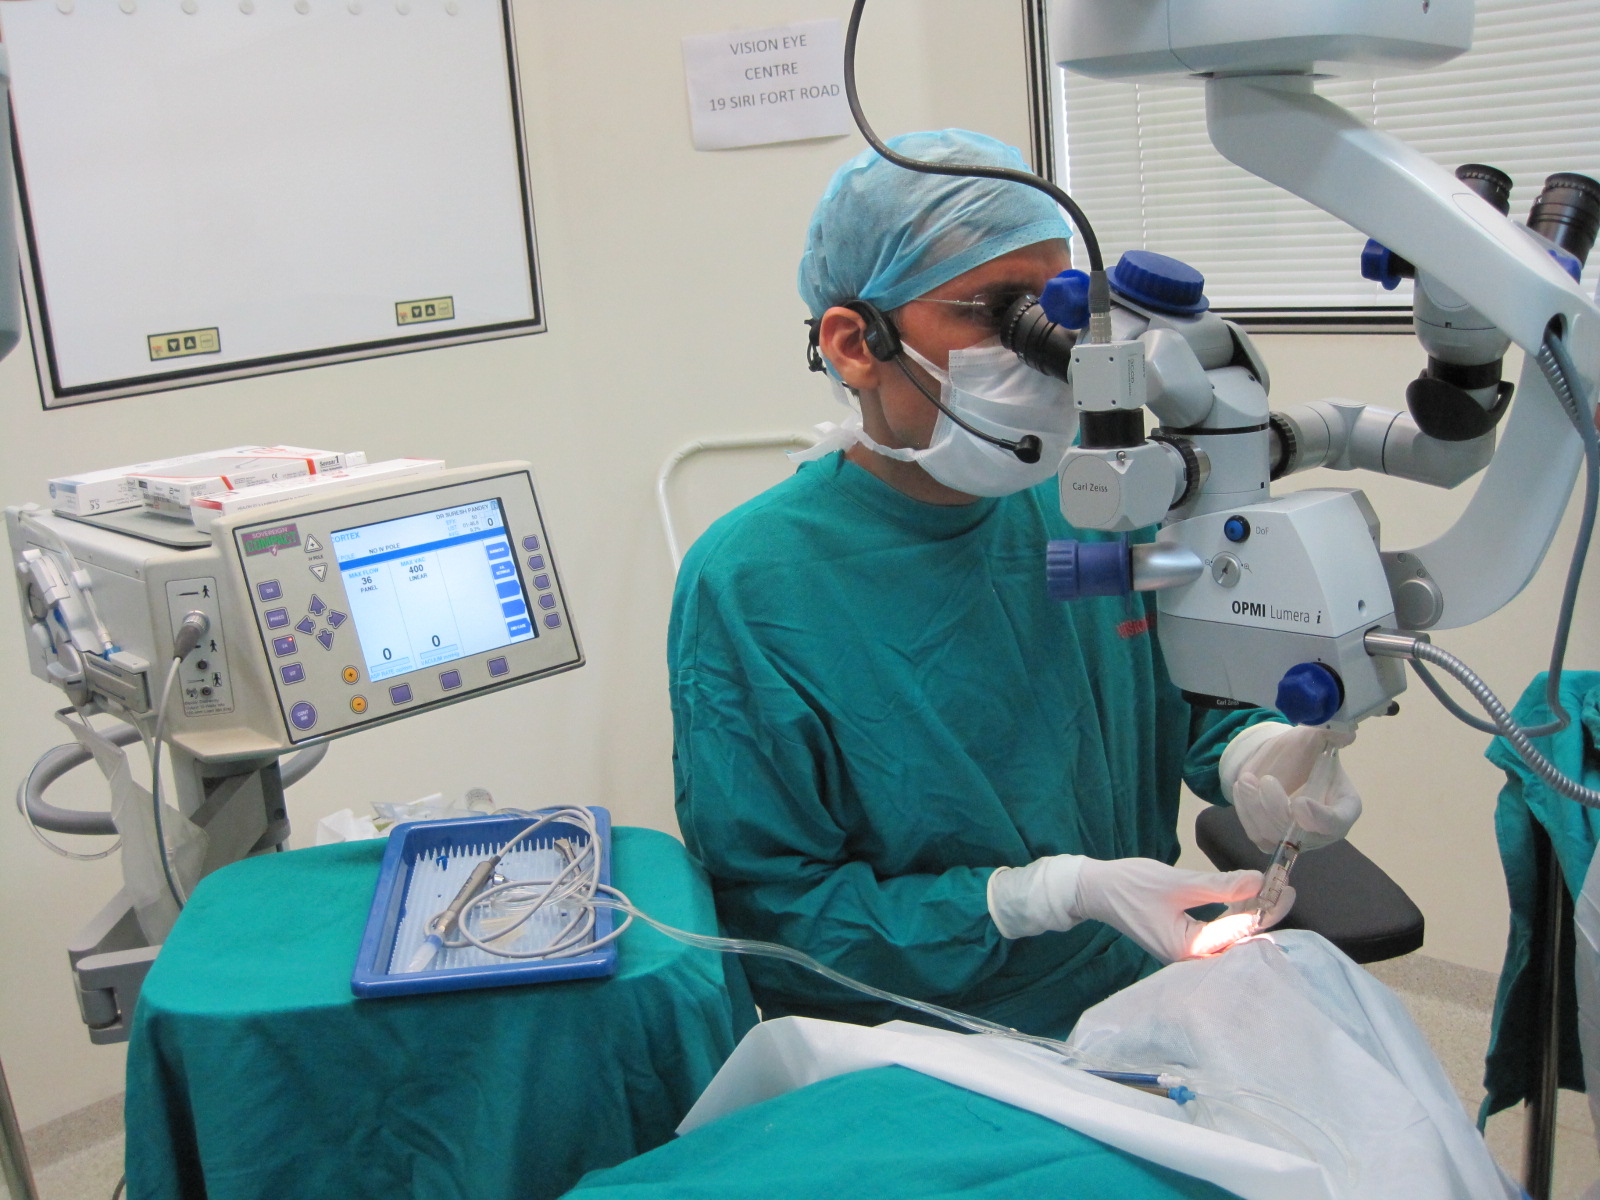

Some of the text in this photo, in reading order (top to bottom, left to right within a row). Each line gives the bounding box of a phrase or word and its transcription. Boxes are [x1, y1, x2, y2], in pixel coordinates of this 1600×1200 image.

[730, 34, 807, 55] VISION EYE
[744, 62, 799, 80] CENTRE
[709, 84, 840, 111] 19 SIRI FORT ROAD
[1072, 482, 1108, 493] Carl Zeiss
[251, 526, 288, 539] SOVEREIGN
[246, 531, 297, 553] COMPACT
[409, 564, 424, 574] 400
[361, 576, 373, 585] 36
[360, 584, 378, 593] PANEL
[1231, 600, 1322, 624] OPMI Lumera i
[431, 634, 441, 647] 0
[383, 647, 392, 660] 0
